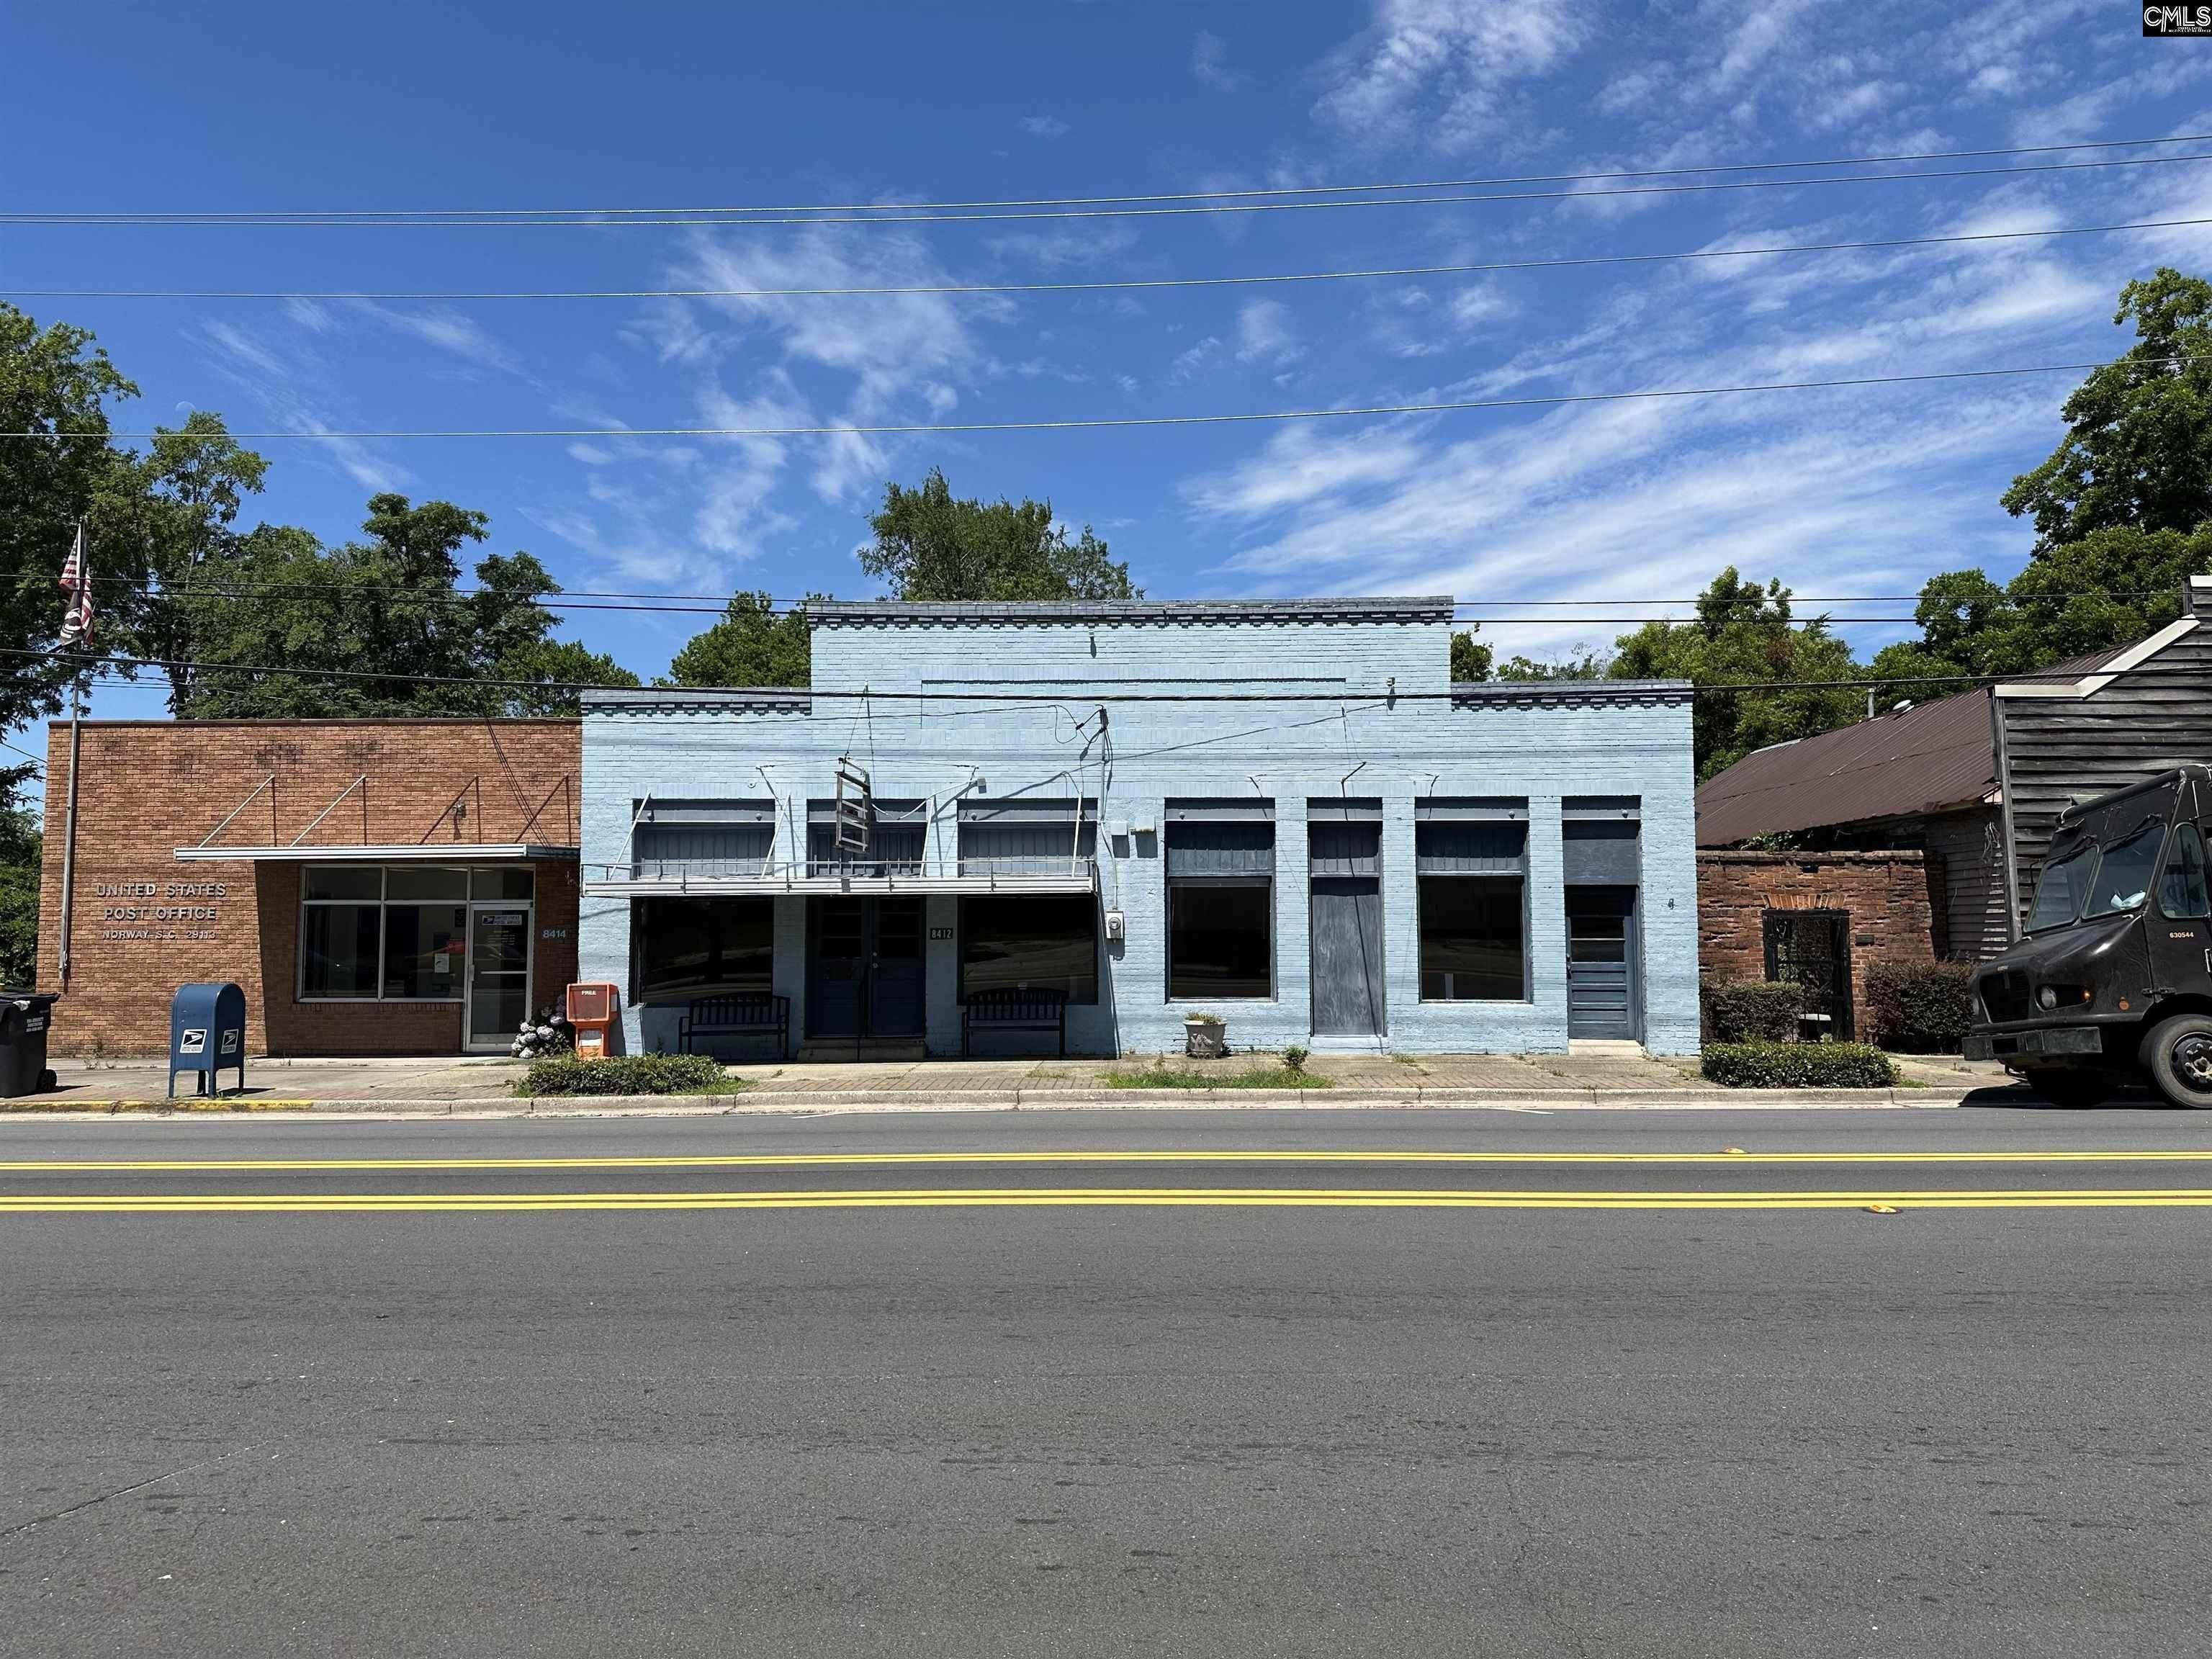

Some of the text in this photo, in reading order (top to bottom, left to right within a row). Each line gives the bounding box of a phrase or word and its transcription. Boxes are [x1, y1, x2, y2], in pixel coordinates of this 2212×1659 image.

[96, 883, 227, 896] UNITED STATES
[104, 907, 217, 920] POST OFFICE
[186, 930, 216, 940] 29113
[543, 930, 565, 938] 8414
[932, 929, 951, 939] 8412
